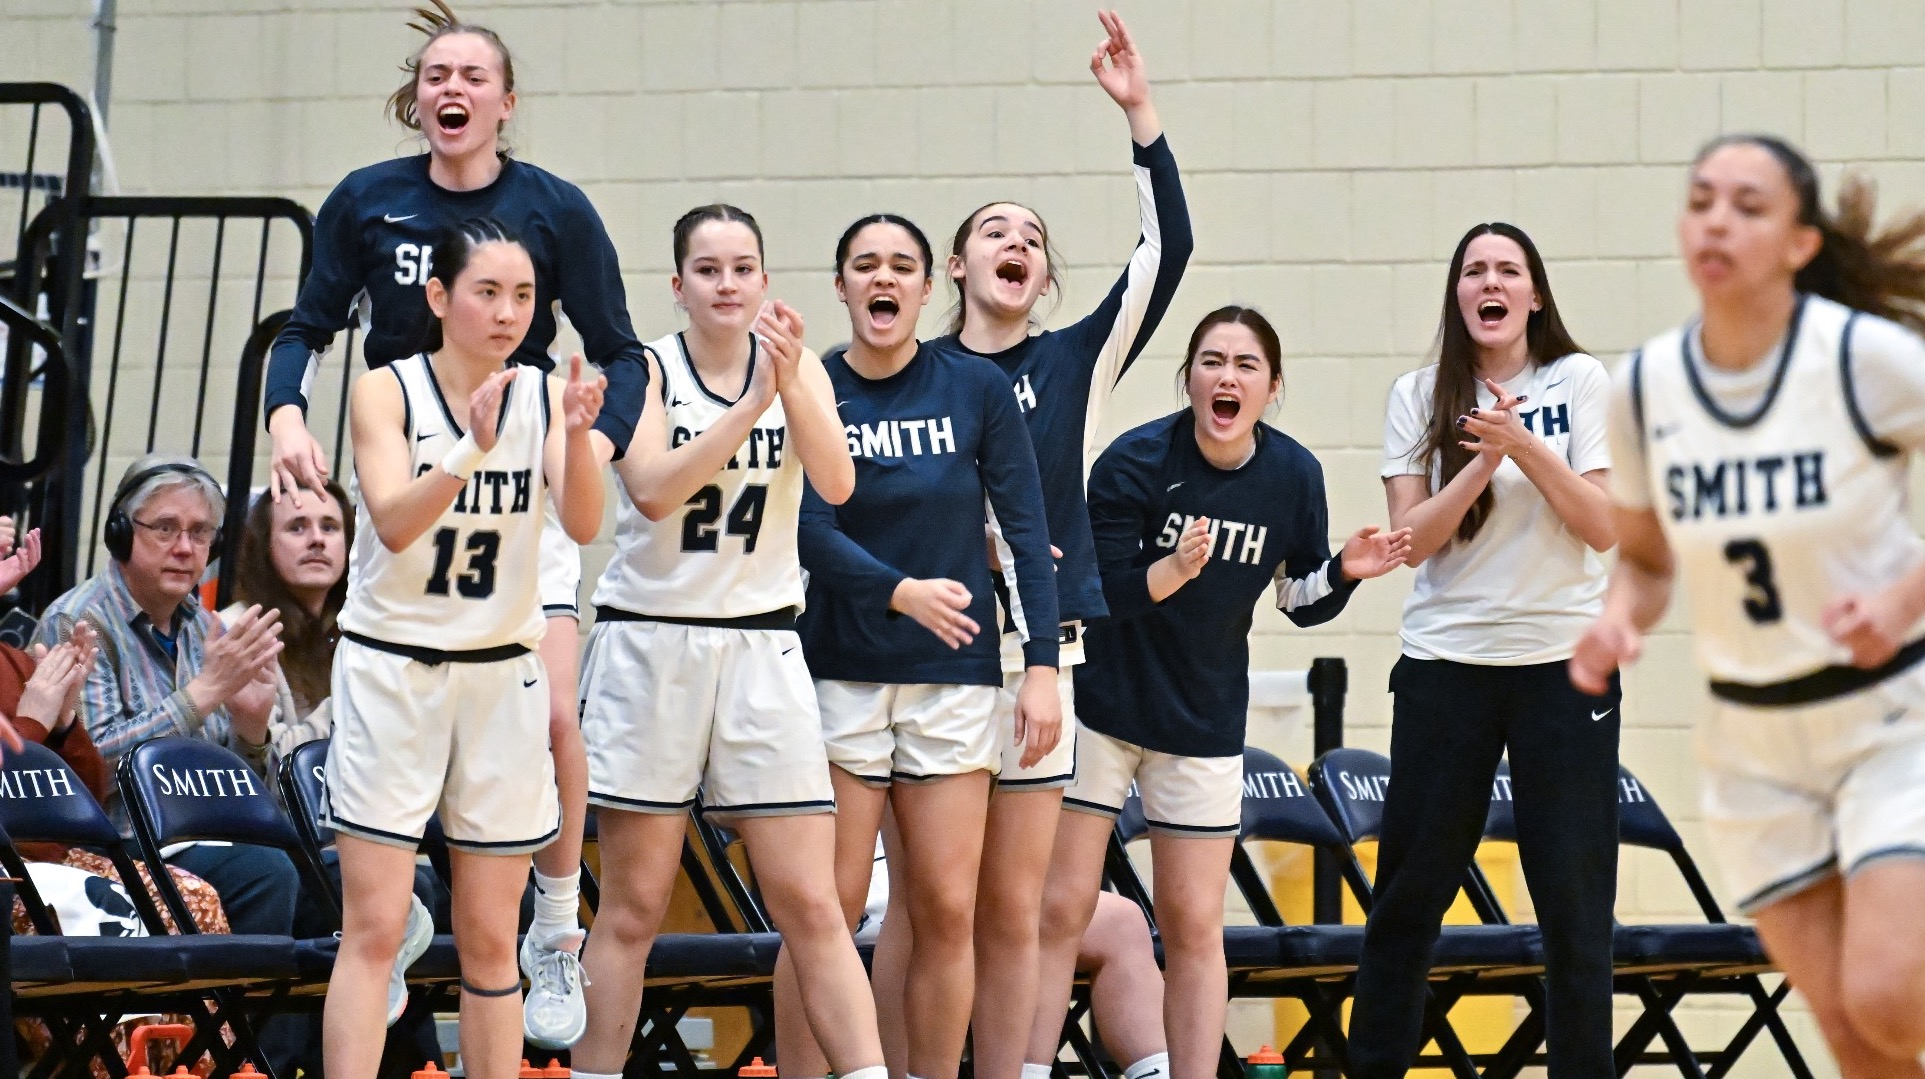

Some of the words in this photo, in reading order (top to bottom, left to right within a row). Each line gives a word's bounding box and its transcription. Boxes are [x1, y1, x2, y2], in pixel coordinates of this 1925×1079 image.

[846, 416, 956, 458] SMITH
[417, 463, 531, 514] ITH
[1667, 451, 1828, 522] SMITH
[680, 483, 769, 555] 24
[424, 526, 501, 600] 13
[1722, 537, 1784, 624] 3
[0, 768, 76, 798] MITH
[152, 763, 258, 797] SMITH
[1242, 771, 1305, 799] MITH
